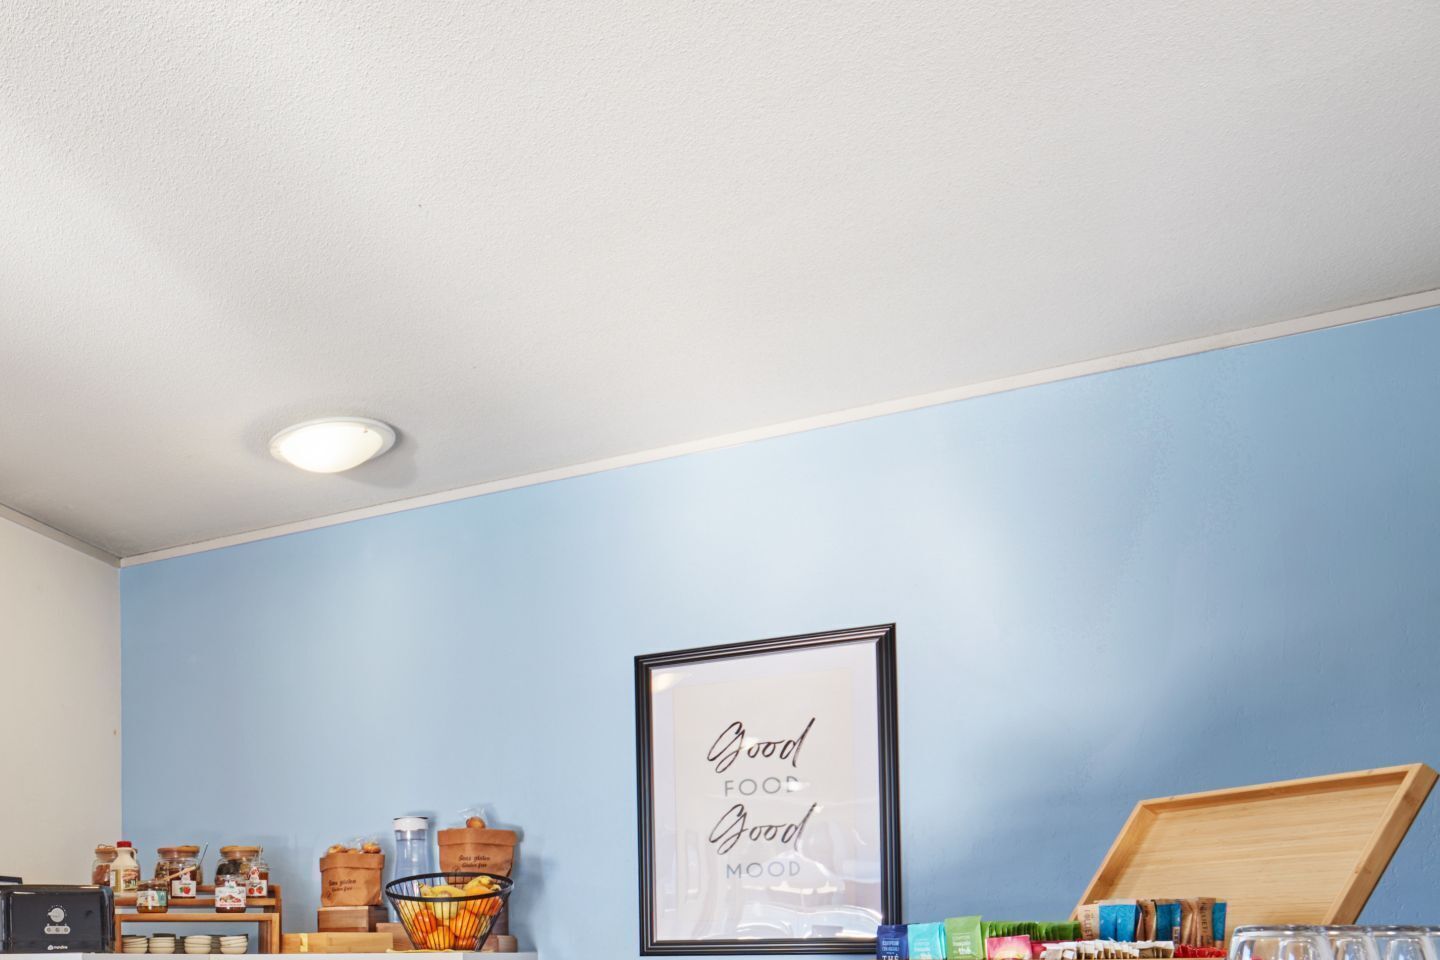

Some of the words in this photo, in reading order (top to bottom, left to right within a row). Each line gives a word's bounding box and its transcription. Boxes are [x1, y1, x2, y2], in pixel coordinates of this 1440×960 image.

[707, 716, 816, 773] Good
[724, 775, 801, 796] FOOD
[708, 802, 817, 855] Good
[726, 860, 801, 879] MOOD
